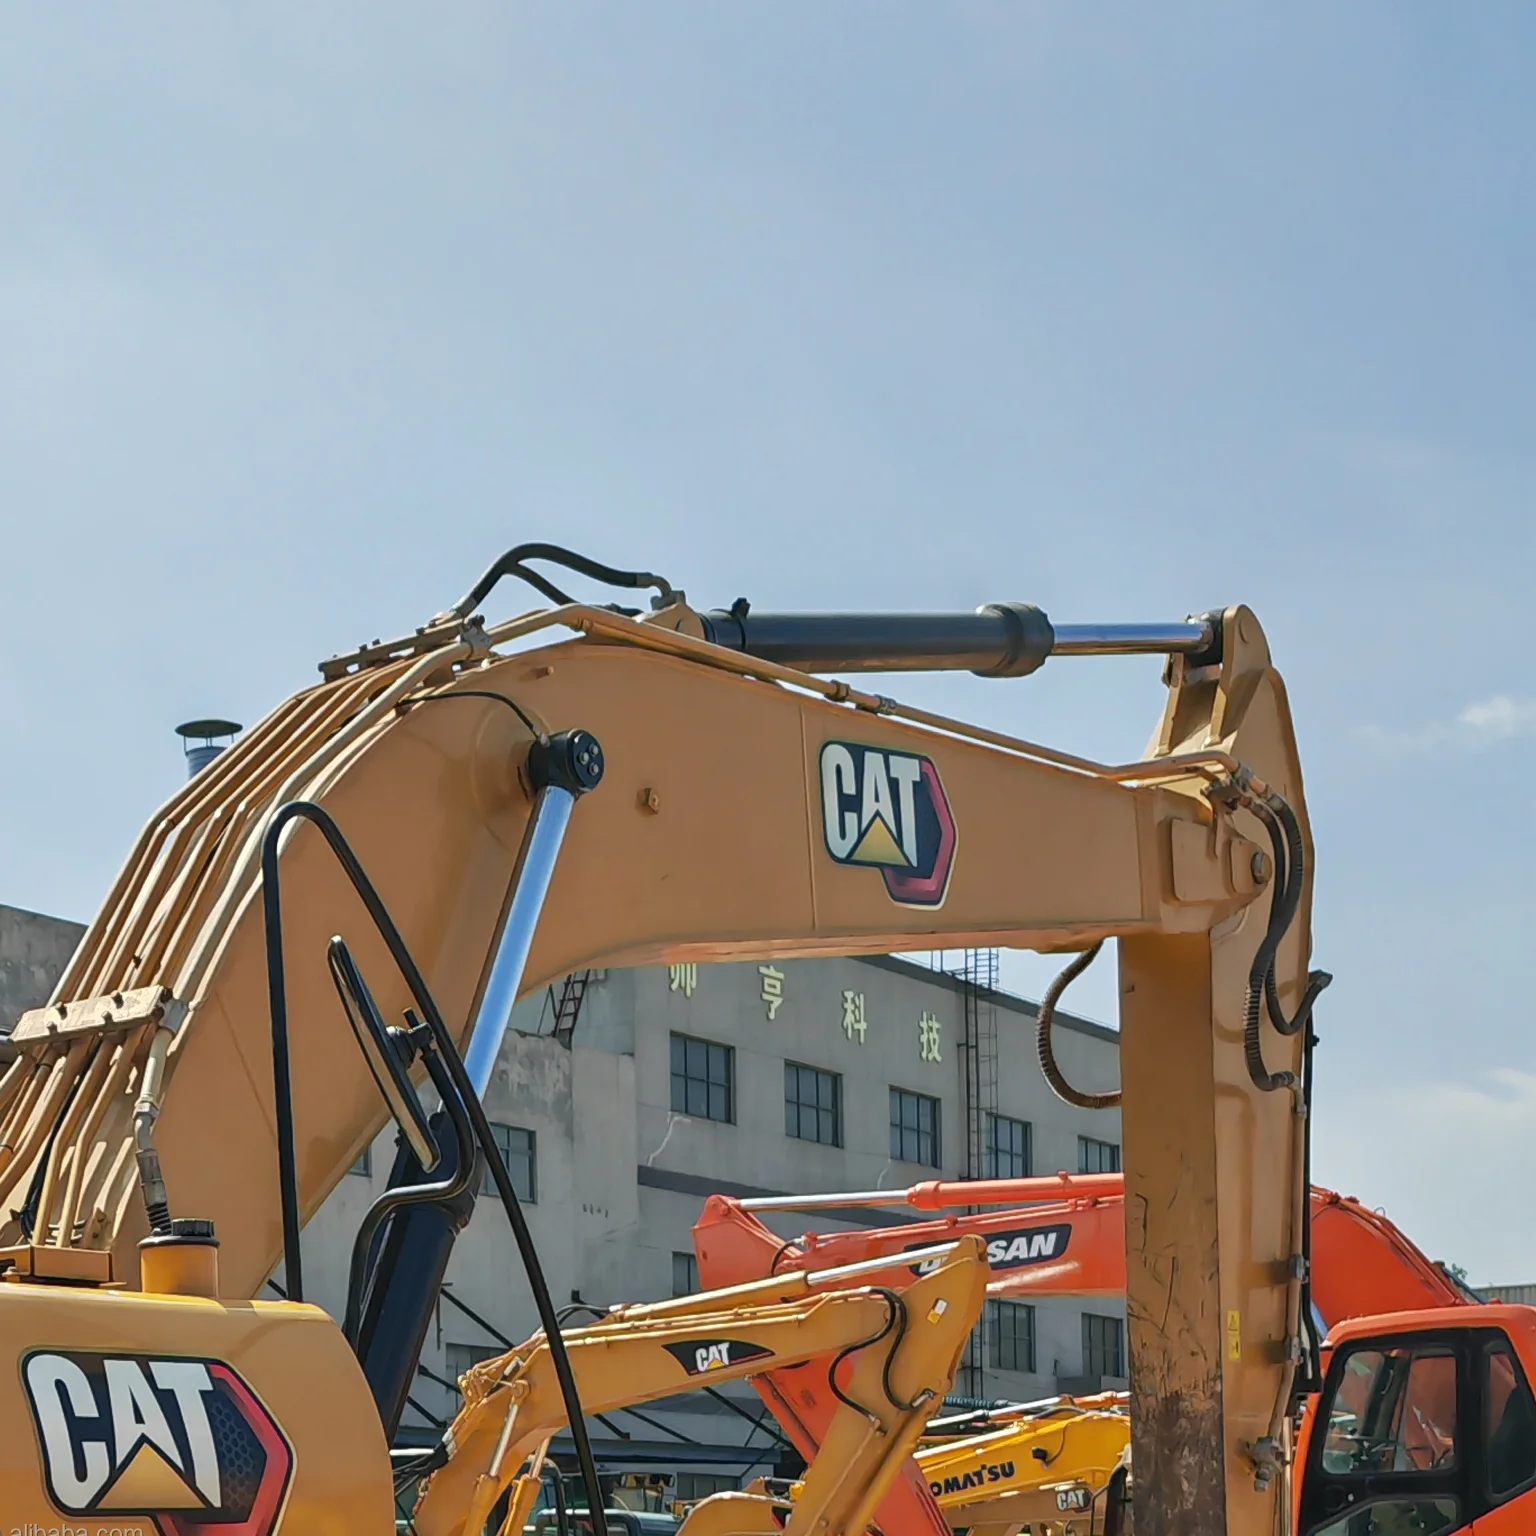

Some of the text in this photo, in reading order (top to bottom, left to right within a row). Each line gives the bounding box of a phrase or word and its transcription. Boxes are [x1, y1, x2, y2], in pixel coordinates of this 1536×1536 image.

[821, 743, 921, 868] CAT
[695, 1342, 730, 1372] CAT
[27, 1354, 222, 1509] CAT
[929, 1461, 1015, 1497] OMATSU
[1057, 1489, 1085, 1511] CAT
